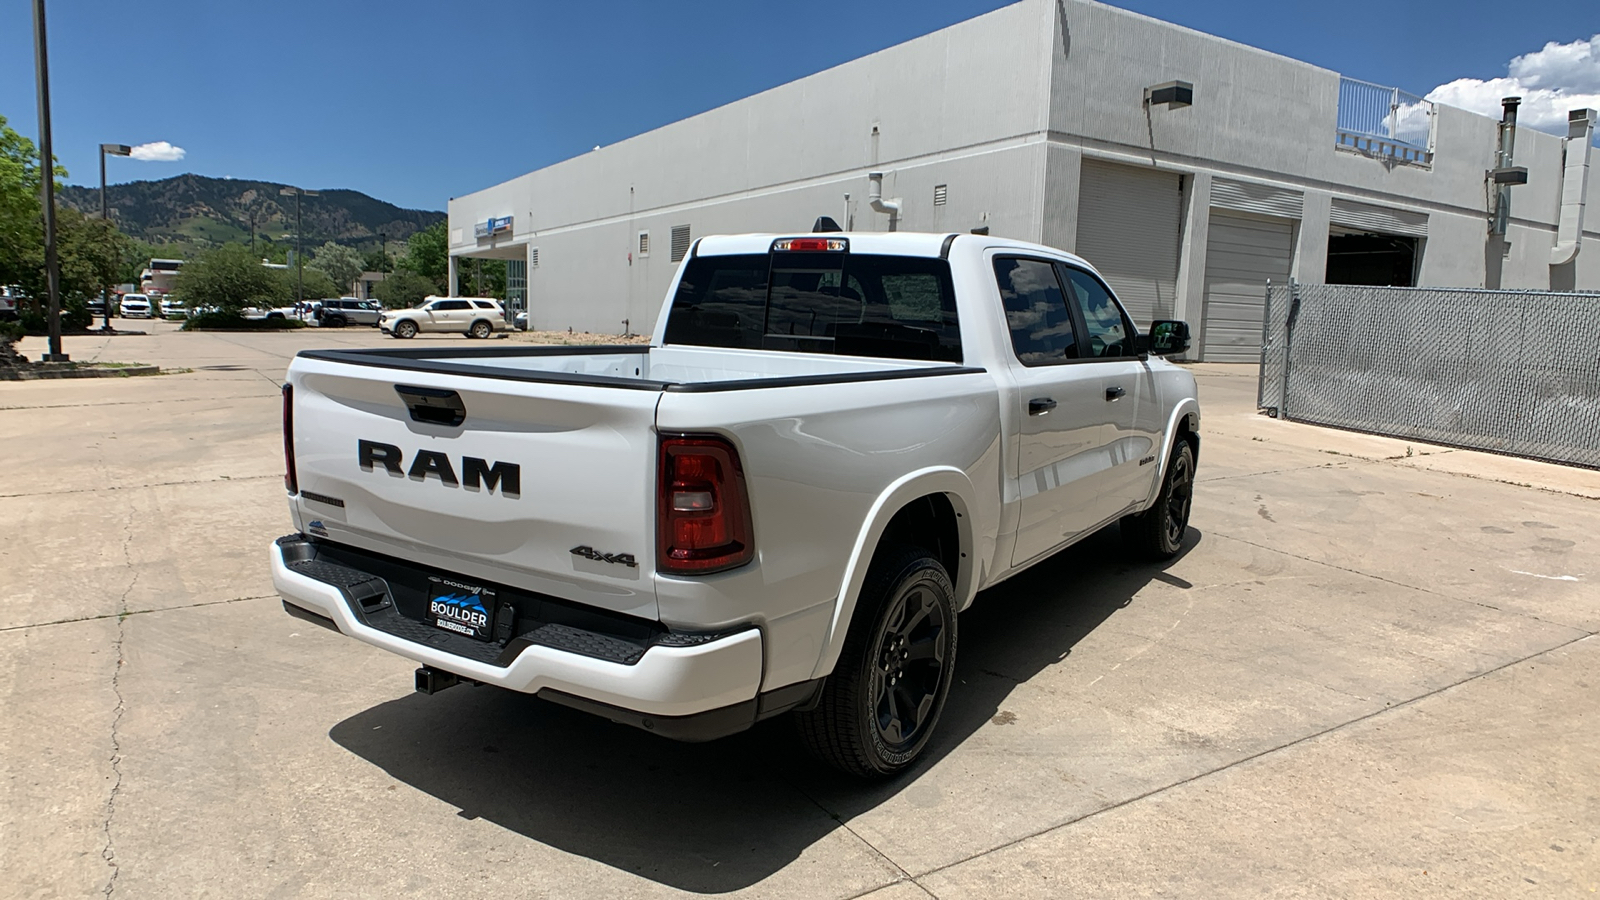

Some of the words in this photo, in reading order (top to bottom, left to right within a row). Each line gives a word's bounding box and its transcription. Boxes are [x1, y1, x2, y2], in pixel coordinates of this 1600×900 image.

[358, 439, 520, 498] RAM
[443, 580, 476, 591] DODGE
[431, 601, 487, 627] BOULDER
